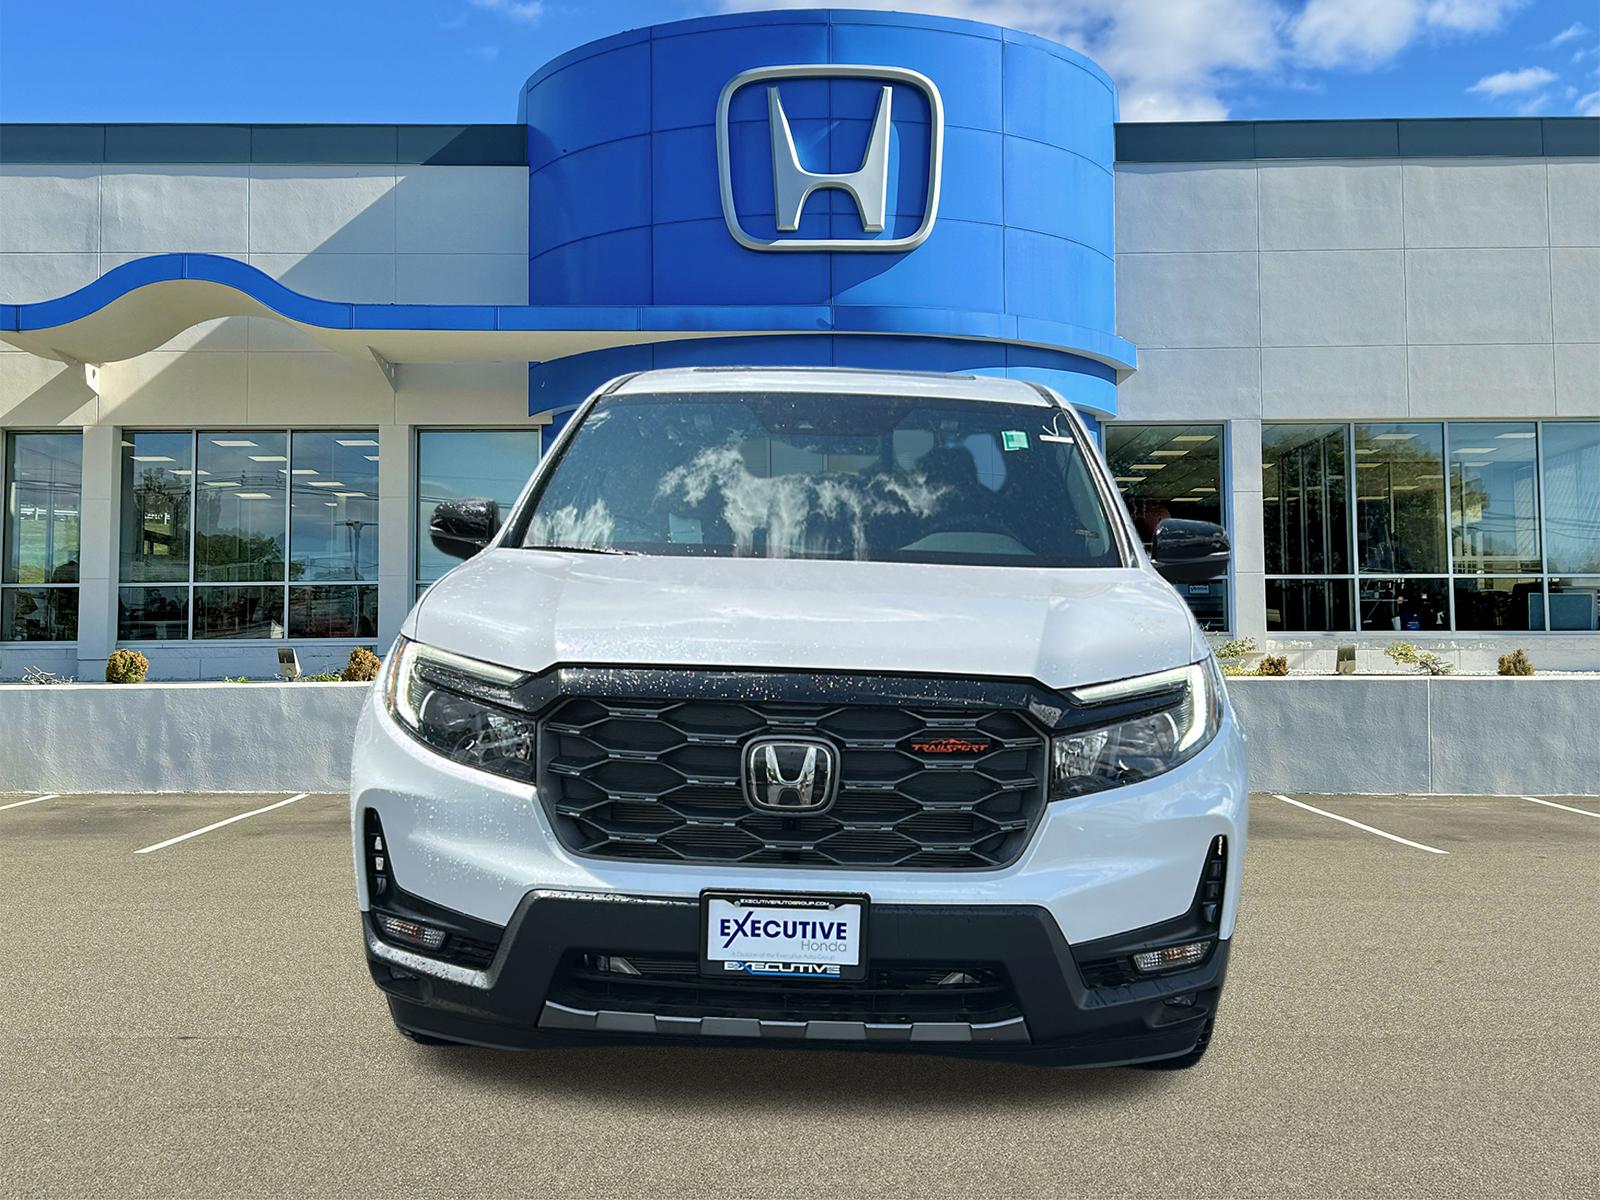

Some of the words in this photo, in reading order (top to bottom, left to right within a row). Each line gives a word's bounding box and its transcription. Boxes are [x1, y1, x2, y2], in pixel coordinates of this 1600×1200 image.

[911, 743, 988, 752] TRAILSPORT
[740, 898, 829, 907] EXECUTIVEAUTOGROUP.COM
[720, 911, 847, 949] EXECUTIVE
[801, 940, 847, 952] Honda
[724, 960, 840, 974] EXECUTIVE
